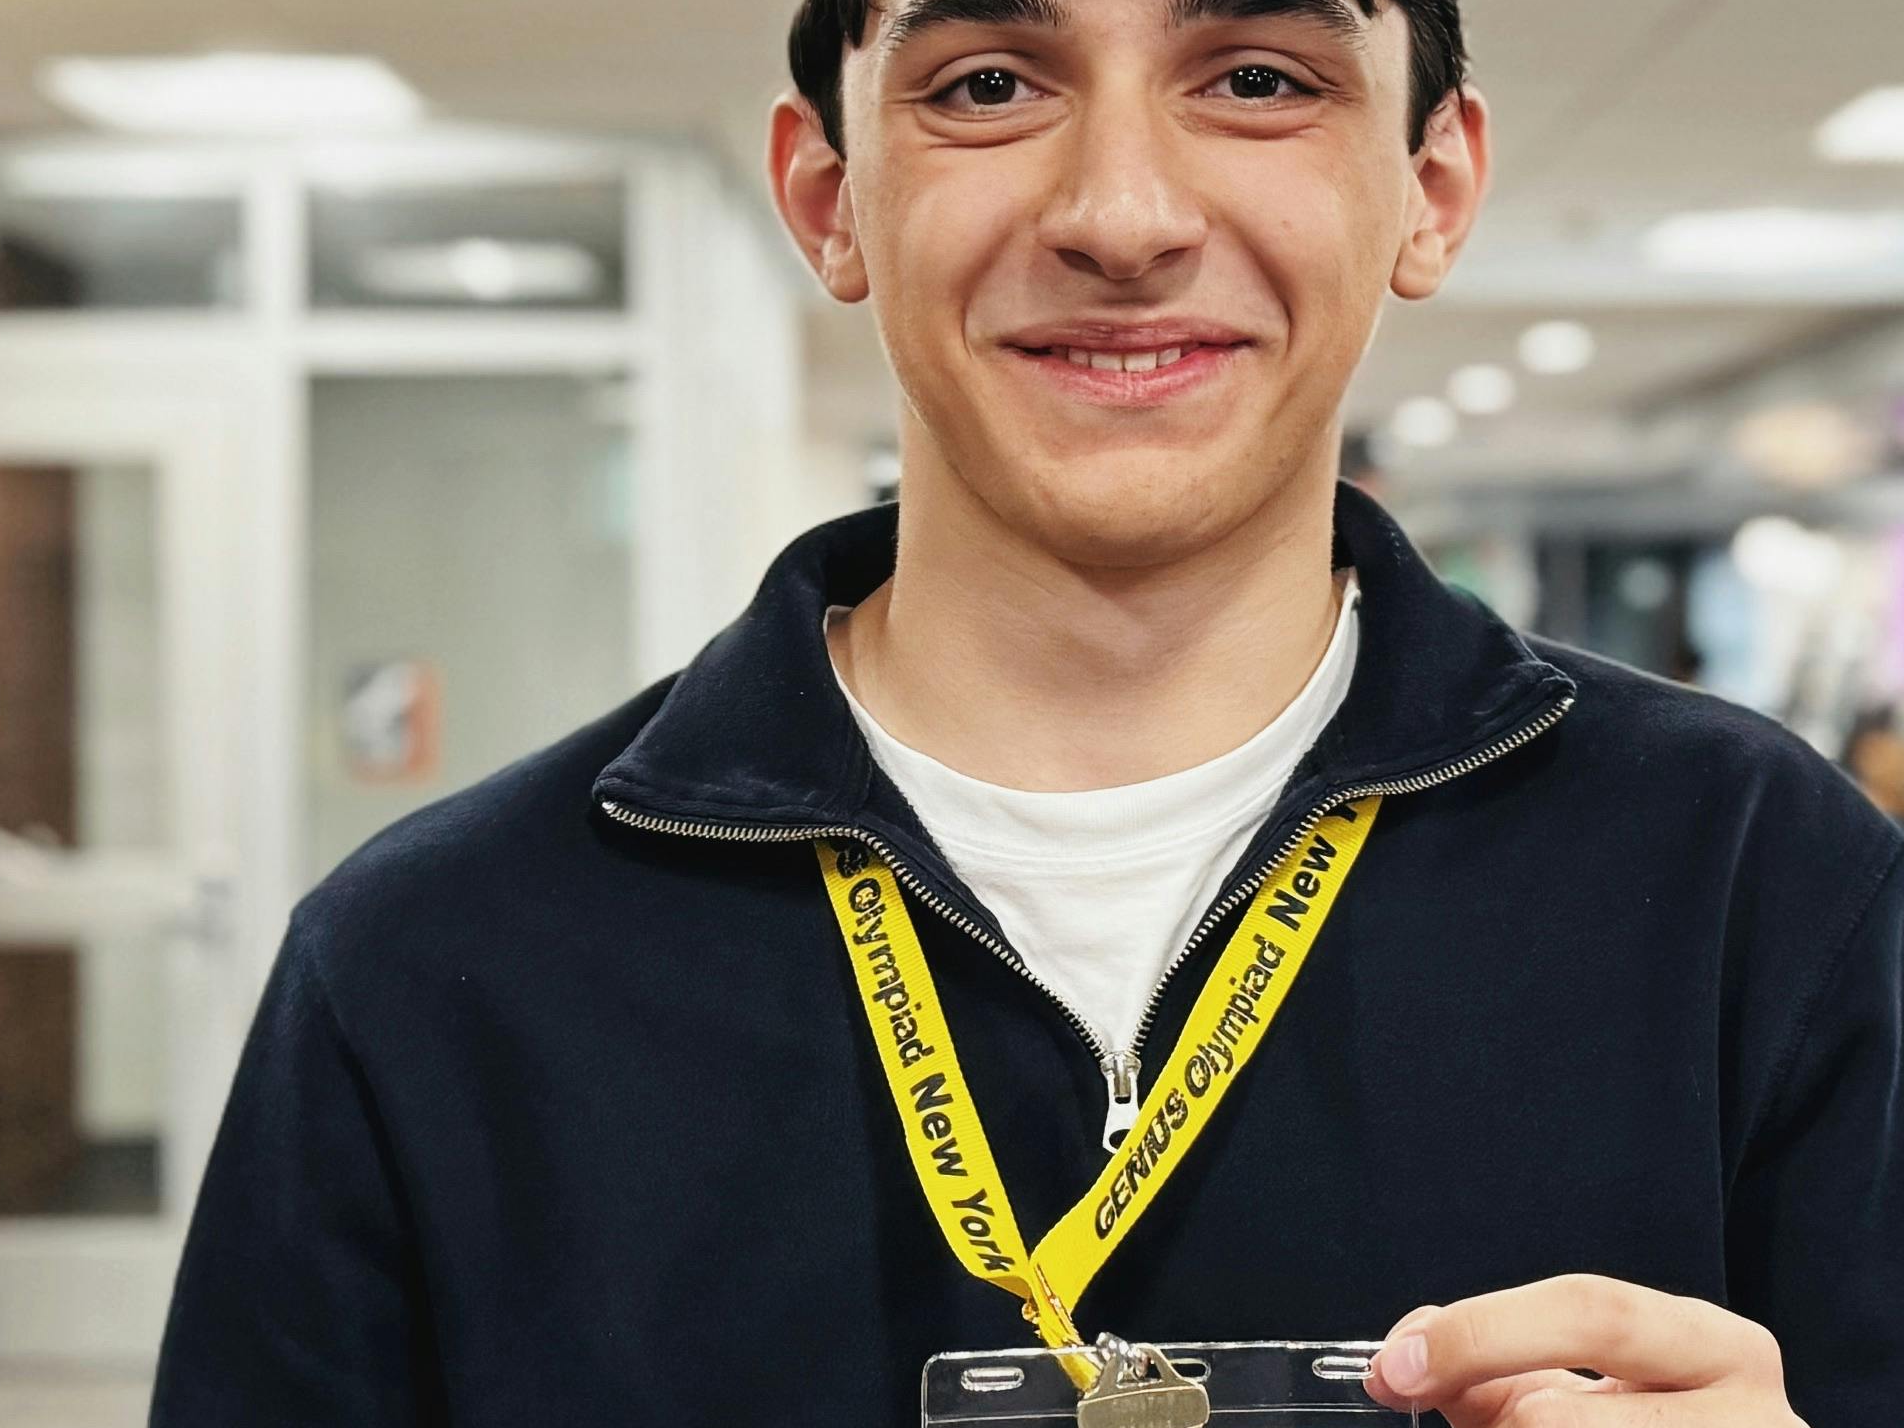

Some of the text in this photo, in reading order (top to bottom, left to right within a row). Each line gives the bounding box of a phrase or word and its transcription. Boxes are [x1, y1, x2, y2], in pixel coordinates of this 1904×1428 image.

[848, 877, 935, 1069] Olympiad
[910, 1072, 969, 1177] New
[951, 1188, 1016, 1272] York
[1184, 933, 1286, 1099] Olympiad
[1264, 832, 1338, 932] New
